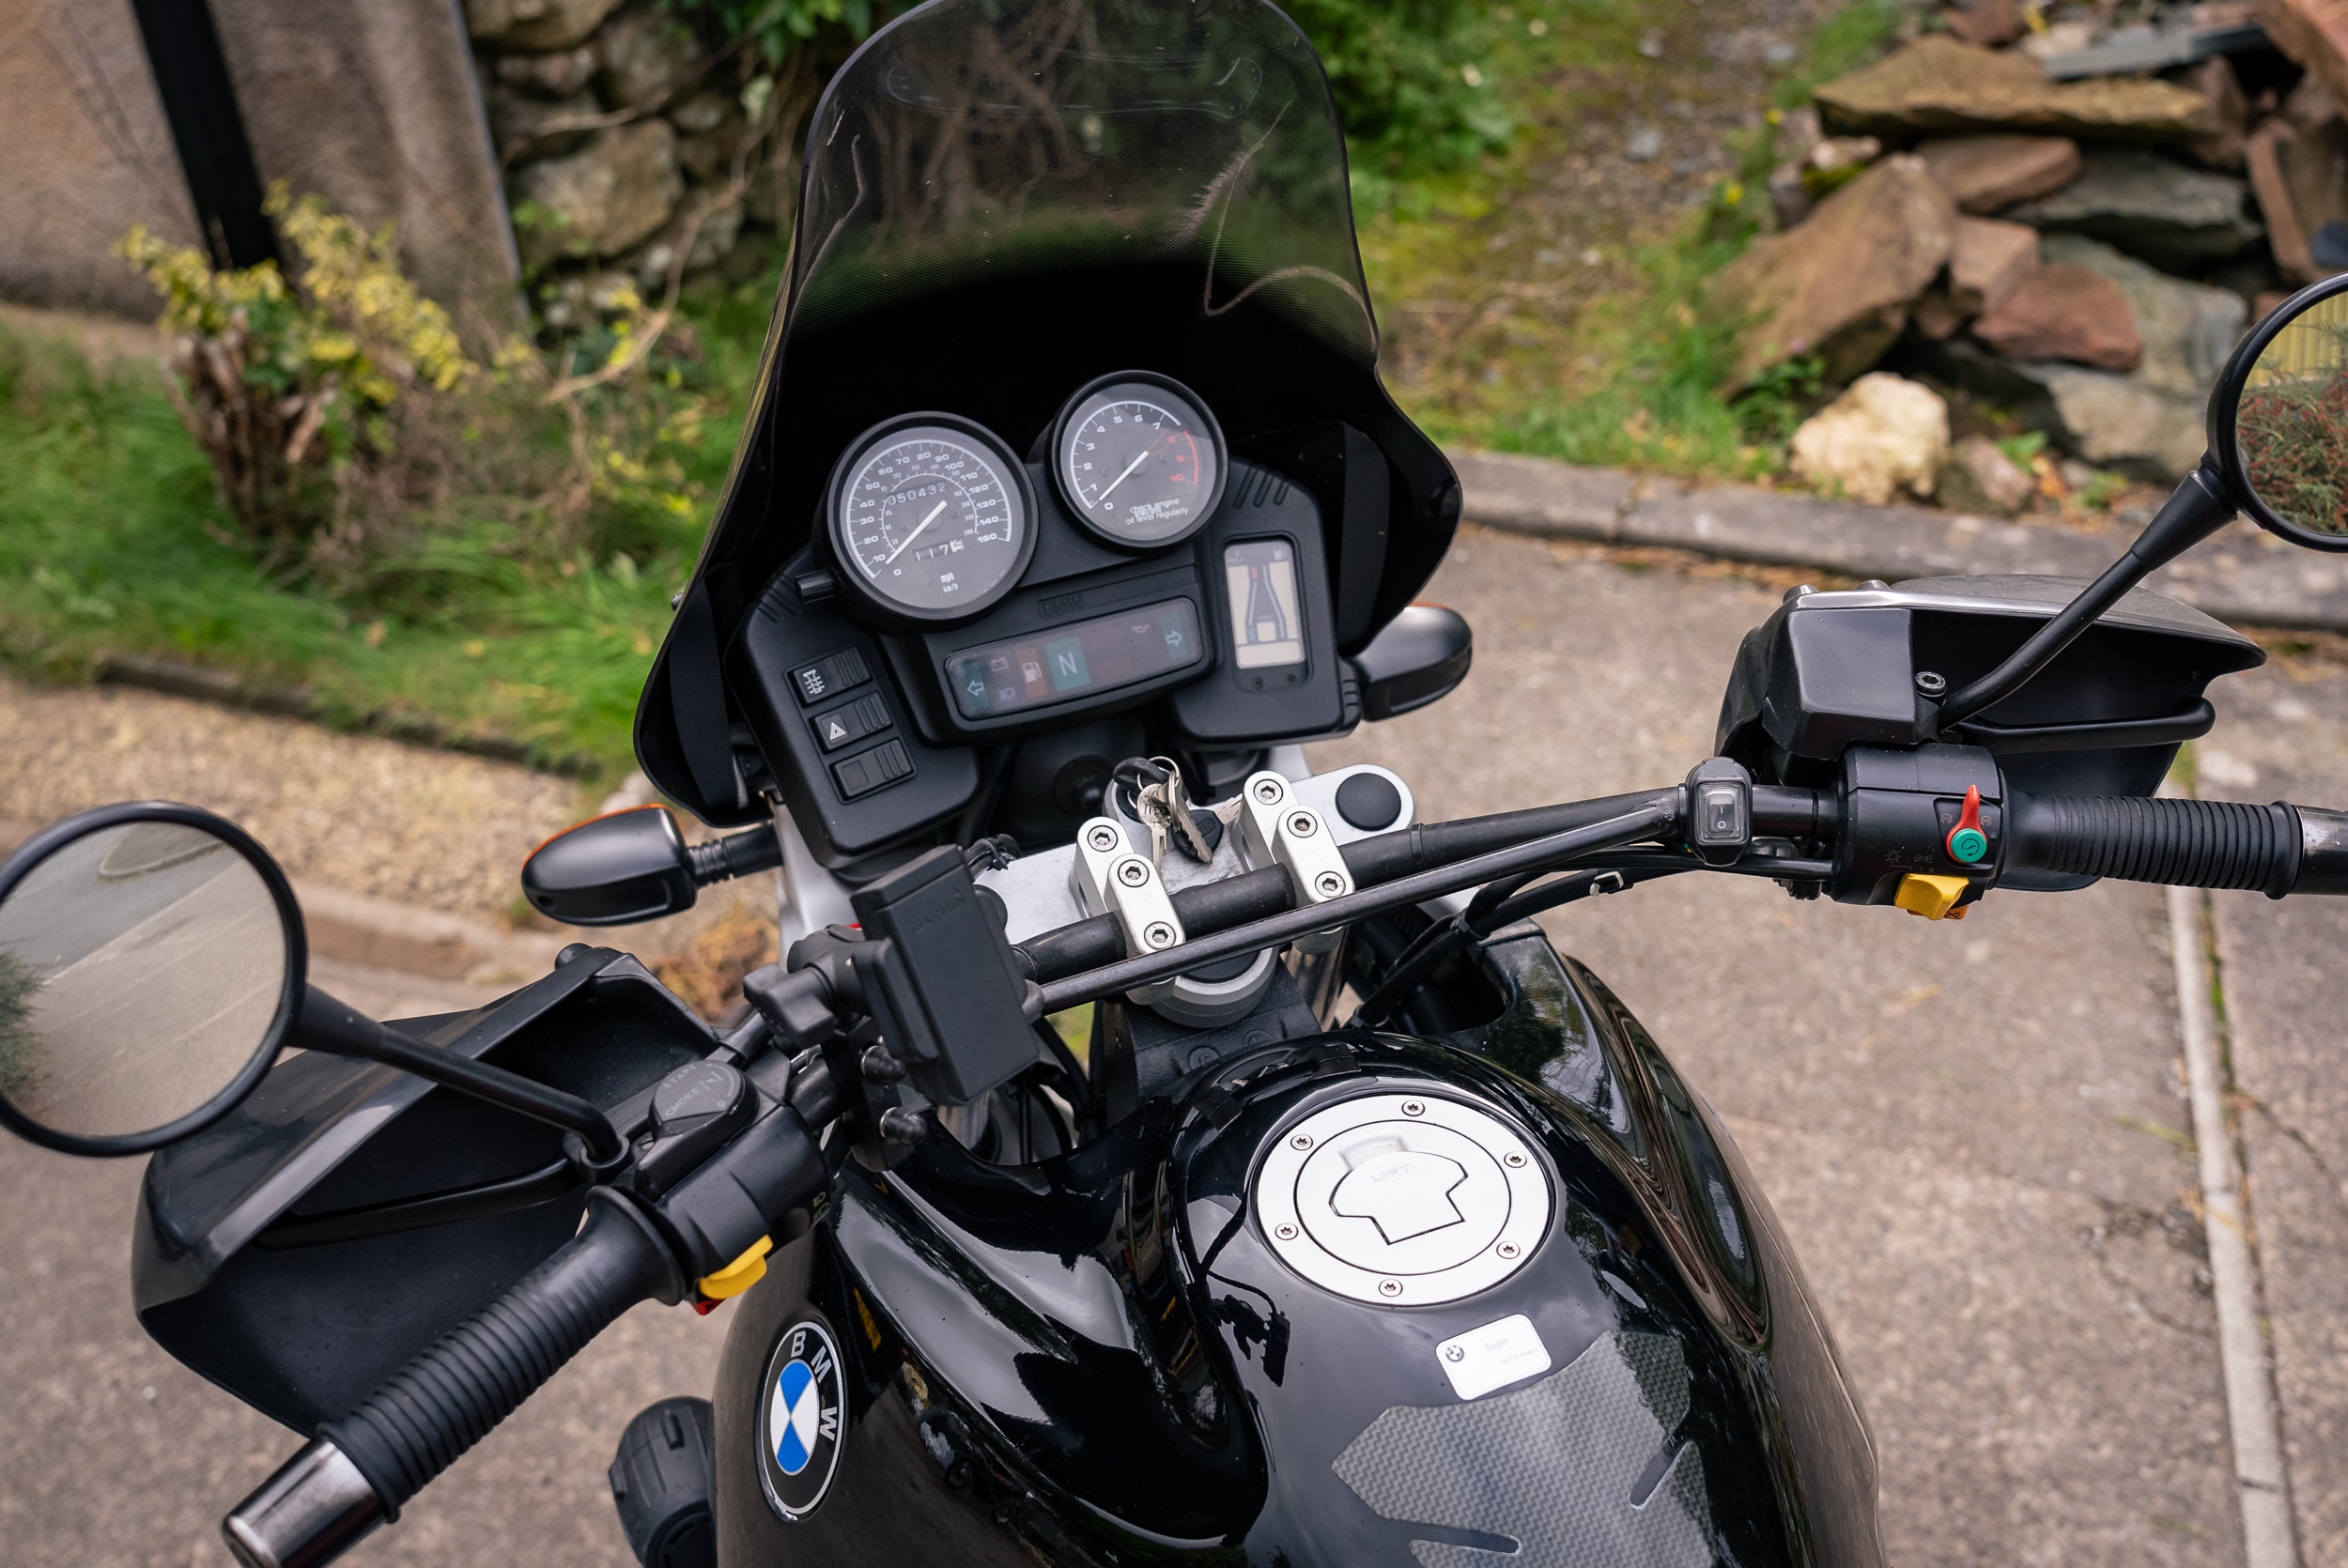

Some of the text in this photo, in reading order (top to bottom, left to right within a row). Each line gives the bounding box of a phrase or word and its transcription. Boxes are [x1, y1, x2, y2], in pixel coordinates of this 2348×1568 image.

[1113, 415, 1122, 423] 5
[1134, 414, 1143, 423] 6
[1151, 422, 1161, 430] 7
[1086, 442, 1095, 451] 3
[895, 456, 910, 466] 70
[917, 452, 932, 461] 80
[935, 453, 950, 463] 90
[944, 461, 965, 470] 100
[1083, 462, 1093, 470] 2
[960, 471, 978, 481] 110
[865, 482, 880, 490] 50
[968, 484, 989, 494] 120
[1089, 483, 1097, 491] 1
[888, 482, 947, 505] 050432
[859, 500, 875, 508] 40
[976, 499, 996, 509] 130
[1104, 501, 1114, 510] 0
[1154, 499, 1180, 509] engine
[859, 515, 874, 525] 30
[980, 515, 999, 526] 140
[1125, 516, 1135, 525] oil
[1155, 507, 1188, 519] regularly
[863, 535, 879, 545] 20
[977, 532, 997, 543] 150
[873, 554, 886, 562] 10
[1042, 593, 1083, 617] BMW
[1058, 652, 1078, 677] N
[913, 886, 966, 932] GARMIN
[664, 1063, 696, 1089] START
[665, 1085, 702, 1117] CHOKE
[1369, 1163, 1411, 1183] LIFT
[1484, 1337, 1508, 1351] Super
[791, 1330, 838, 1441] BMW
